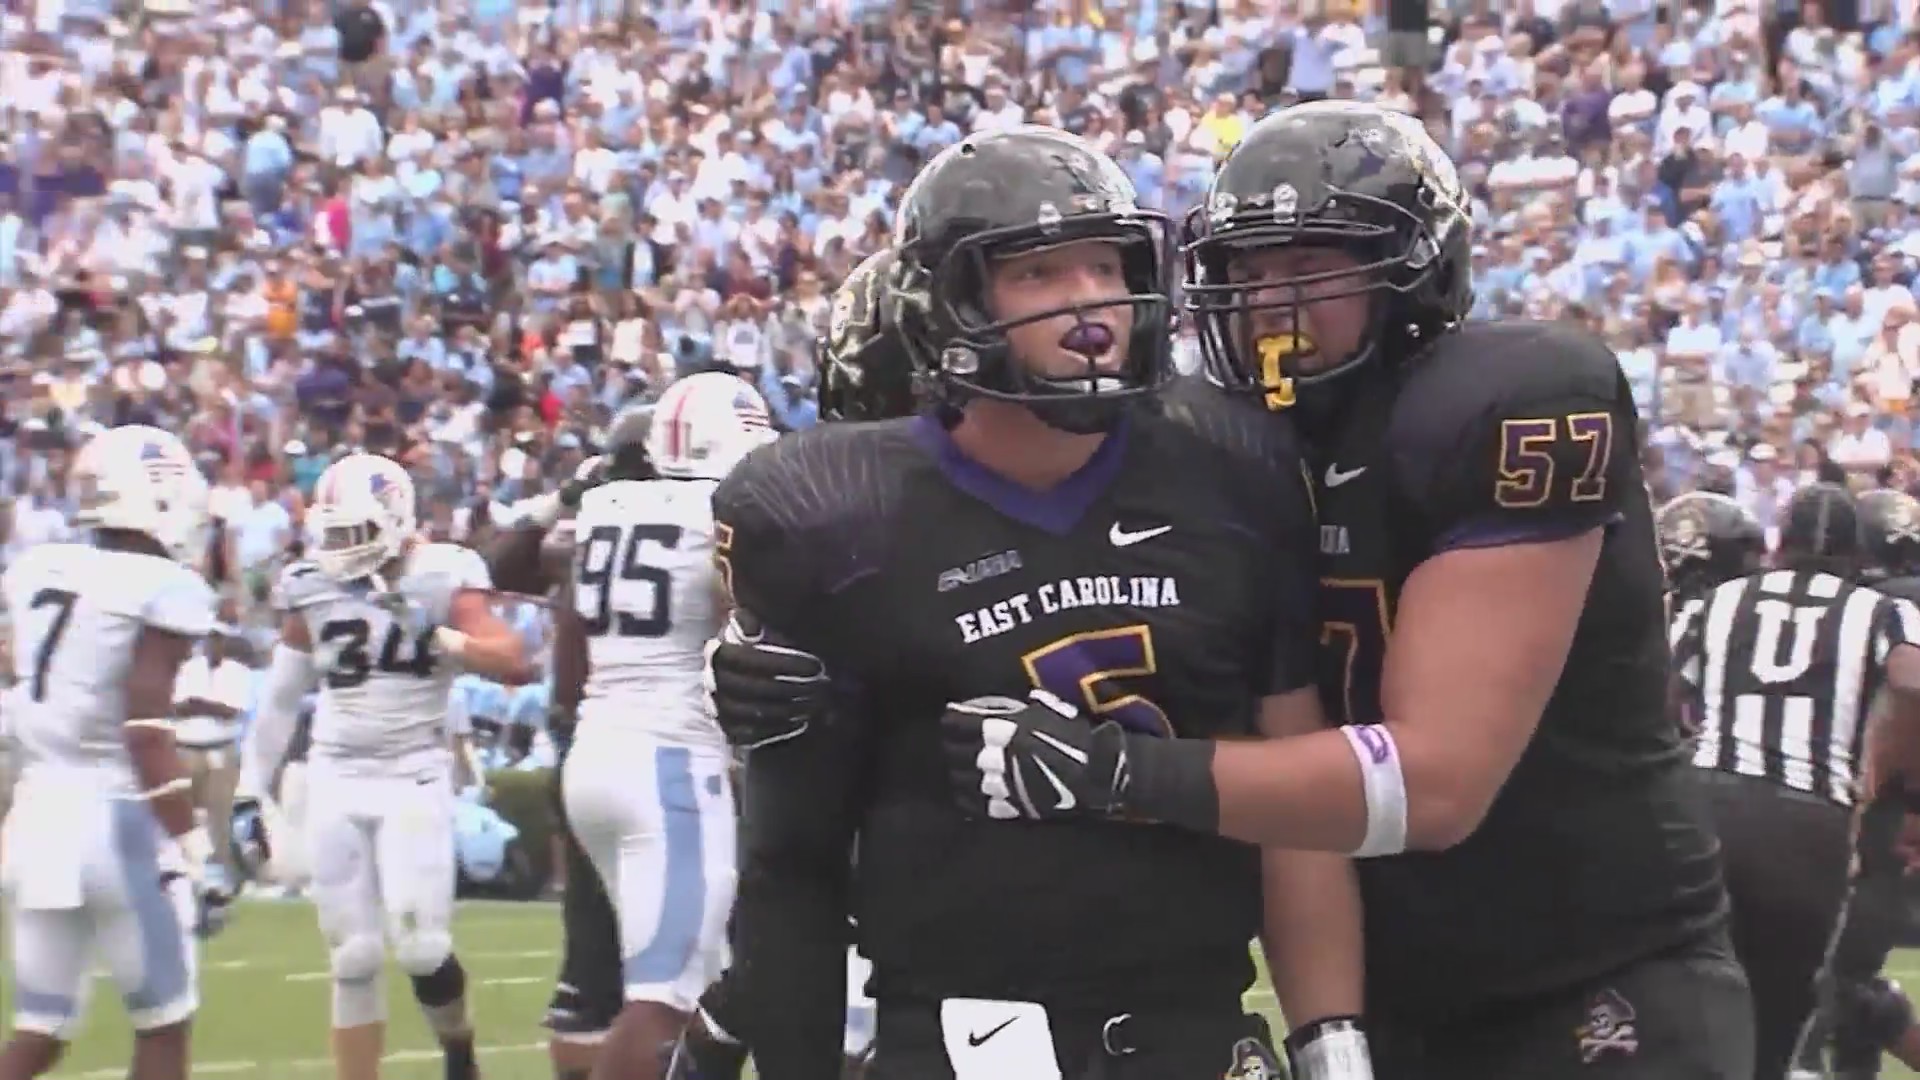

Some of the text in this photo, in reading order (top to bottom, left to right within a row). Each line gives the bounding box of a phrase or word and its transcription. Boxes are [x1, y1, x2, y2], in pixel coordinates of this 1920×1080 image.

[1495, 412, 1612, 507] 57
[574, 523, 684, 638] 95
[955, 576, 1180, 644] EAST CAROLINA
[30, 587, 81, 703] 7
[321, 618, 438, 689] 34
[1021, 624, 1177, 739] 5
[1750, 599, 1829, 684] U
